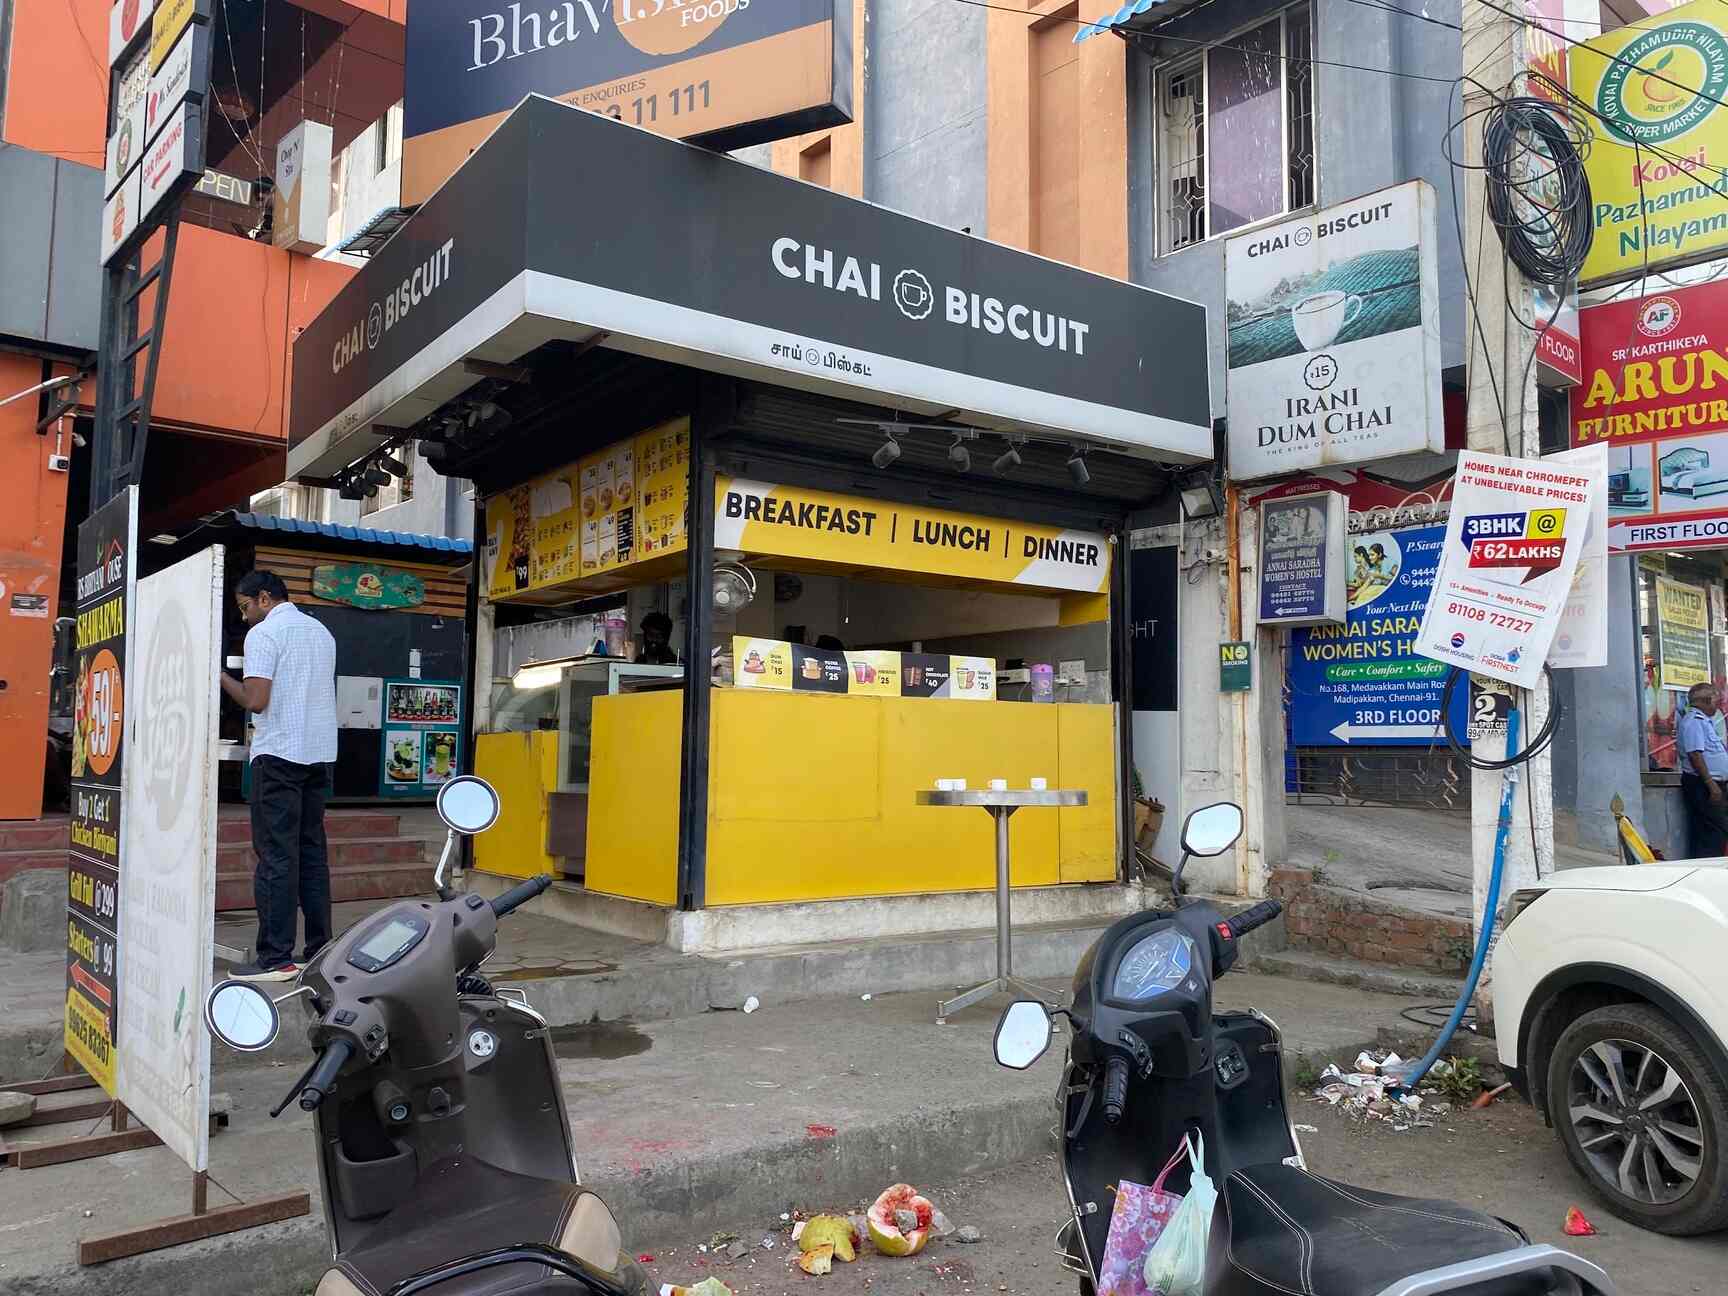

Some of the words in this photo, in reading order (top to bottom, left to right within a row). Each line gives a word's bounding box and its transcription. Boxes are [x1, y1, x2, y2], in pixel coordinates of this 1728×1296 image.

[1603, 83, 1620, 119] KOVAI
[1696, 34, 1725, 84] NILAYAM
[583, 79, 647, 104] ENQUIRIES
[669, 79, 710, 115] 111
[1663, 96, 1712, 135] MARKET
[1632, 146, 1706, 188] Kovai
[199, 168, 252, 206] PEN
[1247, 234, 1289, 258] CHAI
[1317, 203, 1393, 239] BISCUIT
[332, 319, 364, 374] CHAI
[385, 237, 454, 332] BISCUIT
[771, 236, 881, 302] CHAI
[945, 286, 1090, 356] BISCUIT
[1545, 335, 1576, 366] FLOOR
[1631, 335, 1709, 358] KARTHIKEYA
[1285, 387, 1360, 418] IRANI
[1257, 419, 1317, 448] DUM
[1324, 405, 1394, 435] CHAI
[1464, 460, 1495, 474] HOMES
[1497, 467, 1523, 479] NEAR
[1526, 470, 1589, 488] CHROMEPET
[1461, 475, 1473, 484] AT
[1474, 477, 1544, 496] UNBELIEVABLE
[1546, 488, 1588, 504] PRICES!
[725, 491, 876, 536] BREAKFAST
[912, 519, 990, 552] LUNCH
[1023, 535, 1099, 567] DINNER
[1468, 517, 1522, 535] 3BHK
[1630, 526, 1678, 542] FIRST
[1266, 560, 1287, 572] ANNAI
[1483, 543, 1508, 560] 62
[1508, 546, 1561, 559] LAKHS
[76, 596, 124, 650] SHAWARMA
[1367, 604, 1387, 615] Your
[1388, 602, 1409, 613] Next
[1448, 602, 1486, 622] 81108
[1489, 612, 1534, 633] 72727
[1309, 621, 1367, 640] ANNAI
[1371, 617, 1423, 636] SARA
[1303, 639, 1392, 661] WOMEN'S
[1335, 667, 1356, 678] Care
[1366, 662, 1404, 678] Comfort
[1414, 661, 1443, 674] Safety
[1334, 694, 1387, 704] Madipakkam,
[1351, 681, 1406, 693] Medavakkam
[1407, 680, 1430, 691] Main
[1355, 710, 1386, 724] 3RD
[1390, 708, 1442, 724] FLOOR
